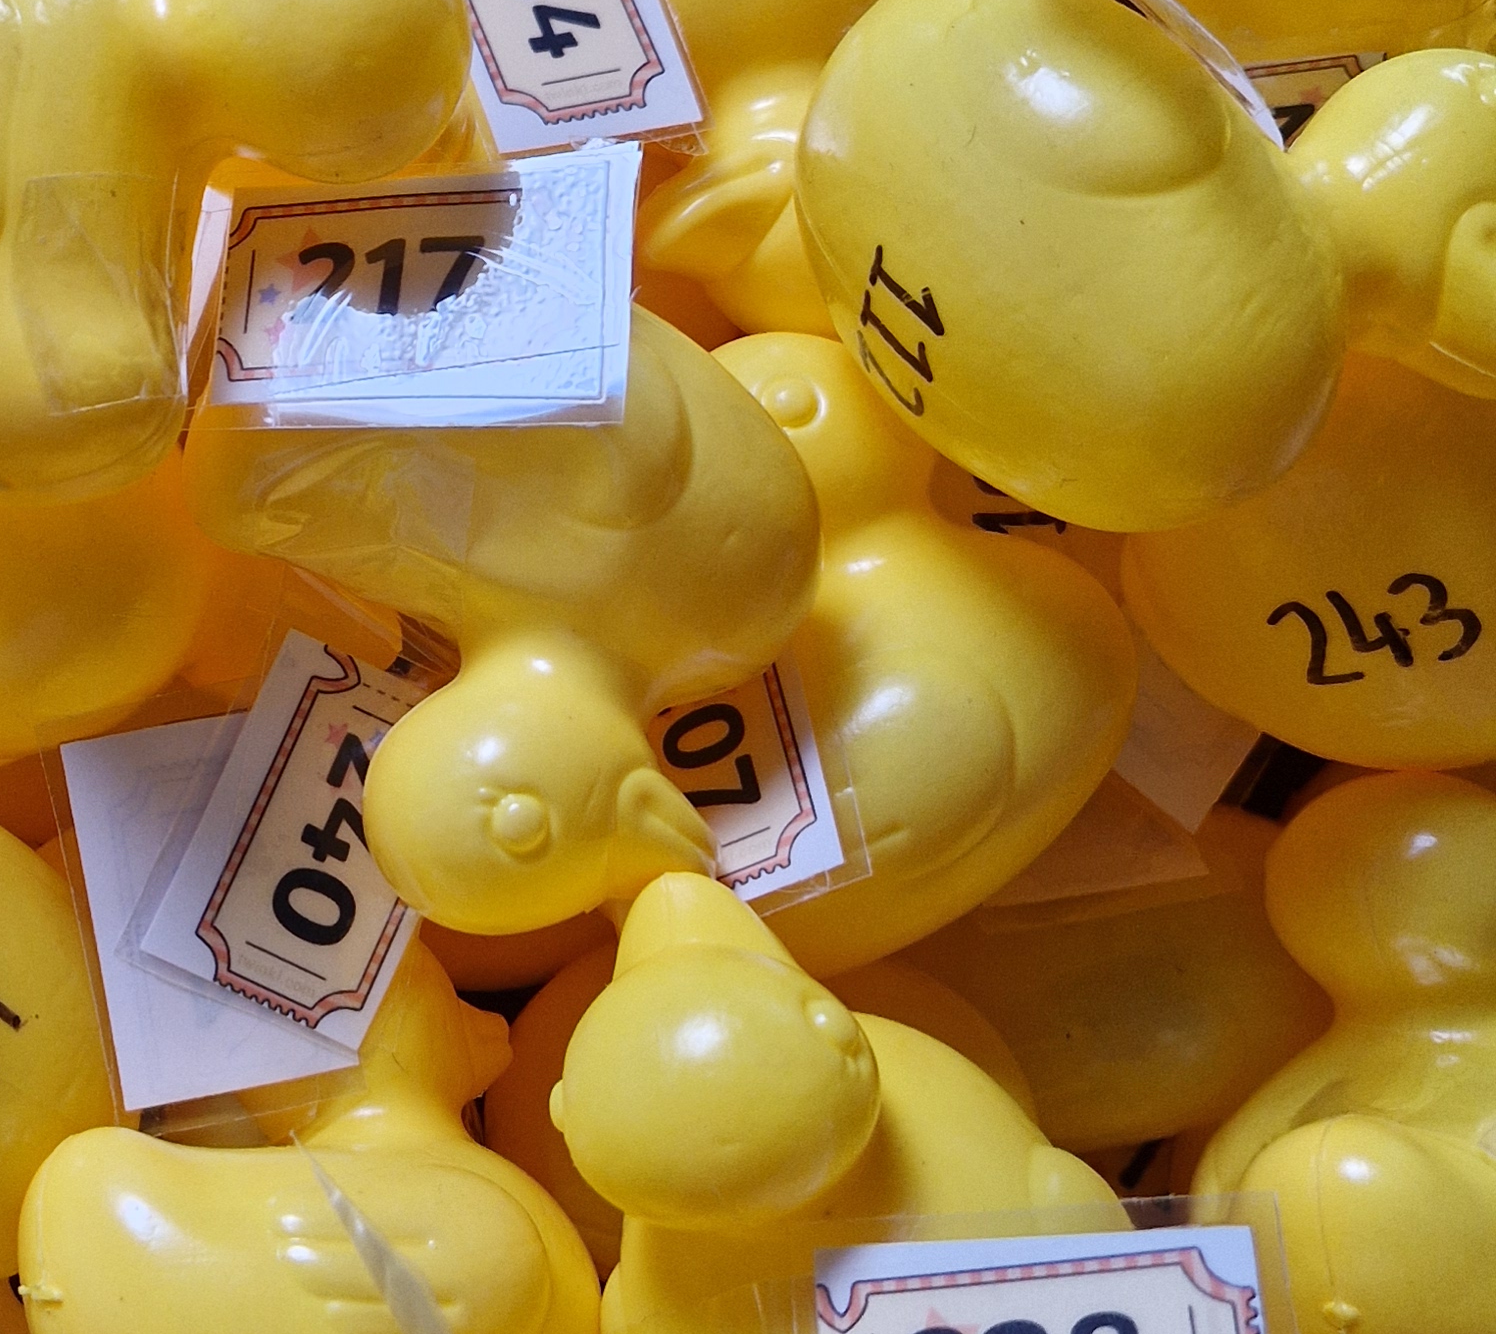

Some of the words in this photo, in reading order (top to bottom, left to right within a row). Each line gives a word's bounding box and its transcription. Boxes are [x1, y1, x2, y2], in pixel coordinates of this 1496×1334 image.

[297, 233, 486, 317] 217
[1266, 572, 1482, 687] 243
[657, 703, 762, 809] 07
